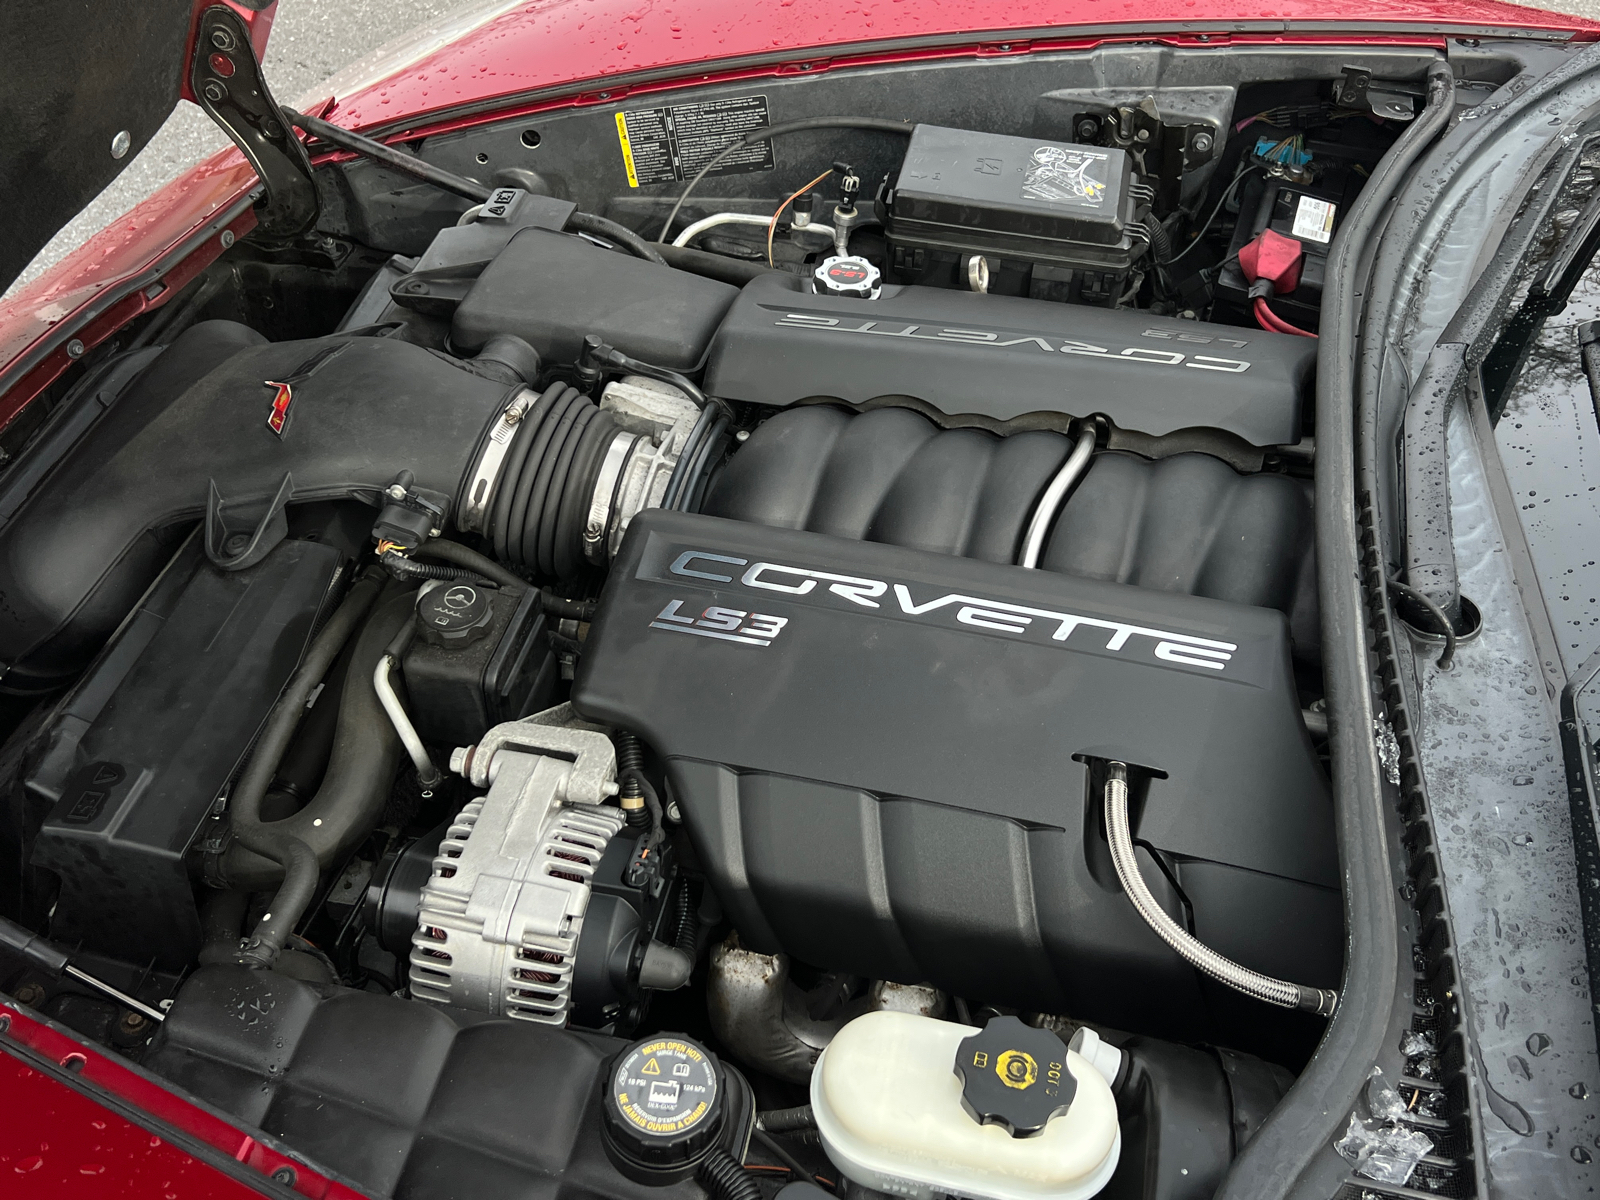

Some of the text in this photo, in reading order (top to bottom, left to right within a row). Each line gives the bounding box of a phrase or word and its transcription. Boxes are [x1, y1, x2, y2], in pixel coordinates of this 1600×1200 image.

[774, 314, 1252, 373] CORVETTE
[1141, 327, 1252, 349] LS3
[669, 550, 1238, 670] CORVETTE
[650, 599, 789, 646] LS3
[642, 1042, 702, 1062] NEVER OPEN HOT!
[673, 1050, 687, 1060] TANK
[635, 1078, 647, 1086] PSI
[1047, 1061, 1062, 1087] DOT
[619, 1093, 629, 1105] NE
[694, 1084, 706, 1093] kPa
[622, 1104, 648, 1128] JAMAIS
[683, 1101, 708, 1126] CHAUD!
[647, 1122, 676, 1131] OUVRIR
